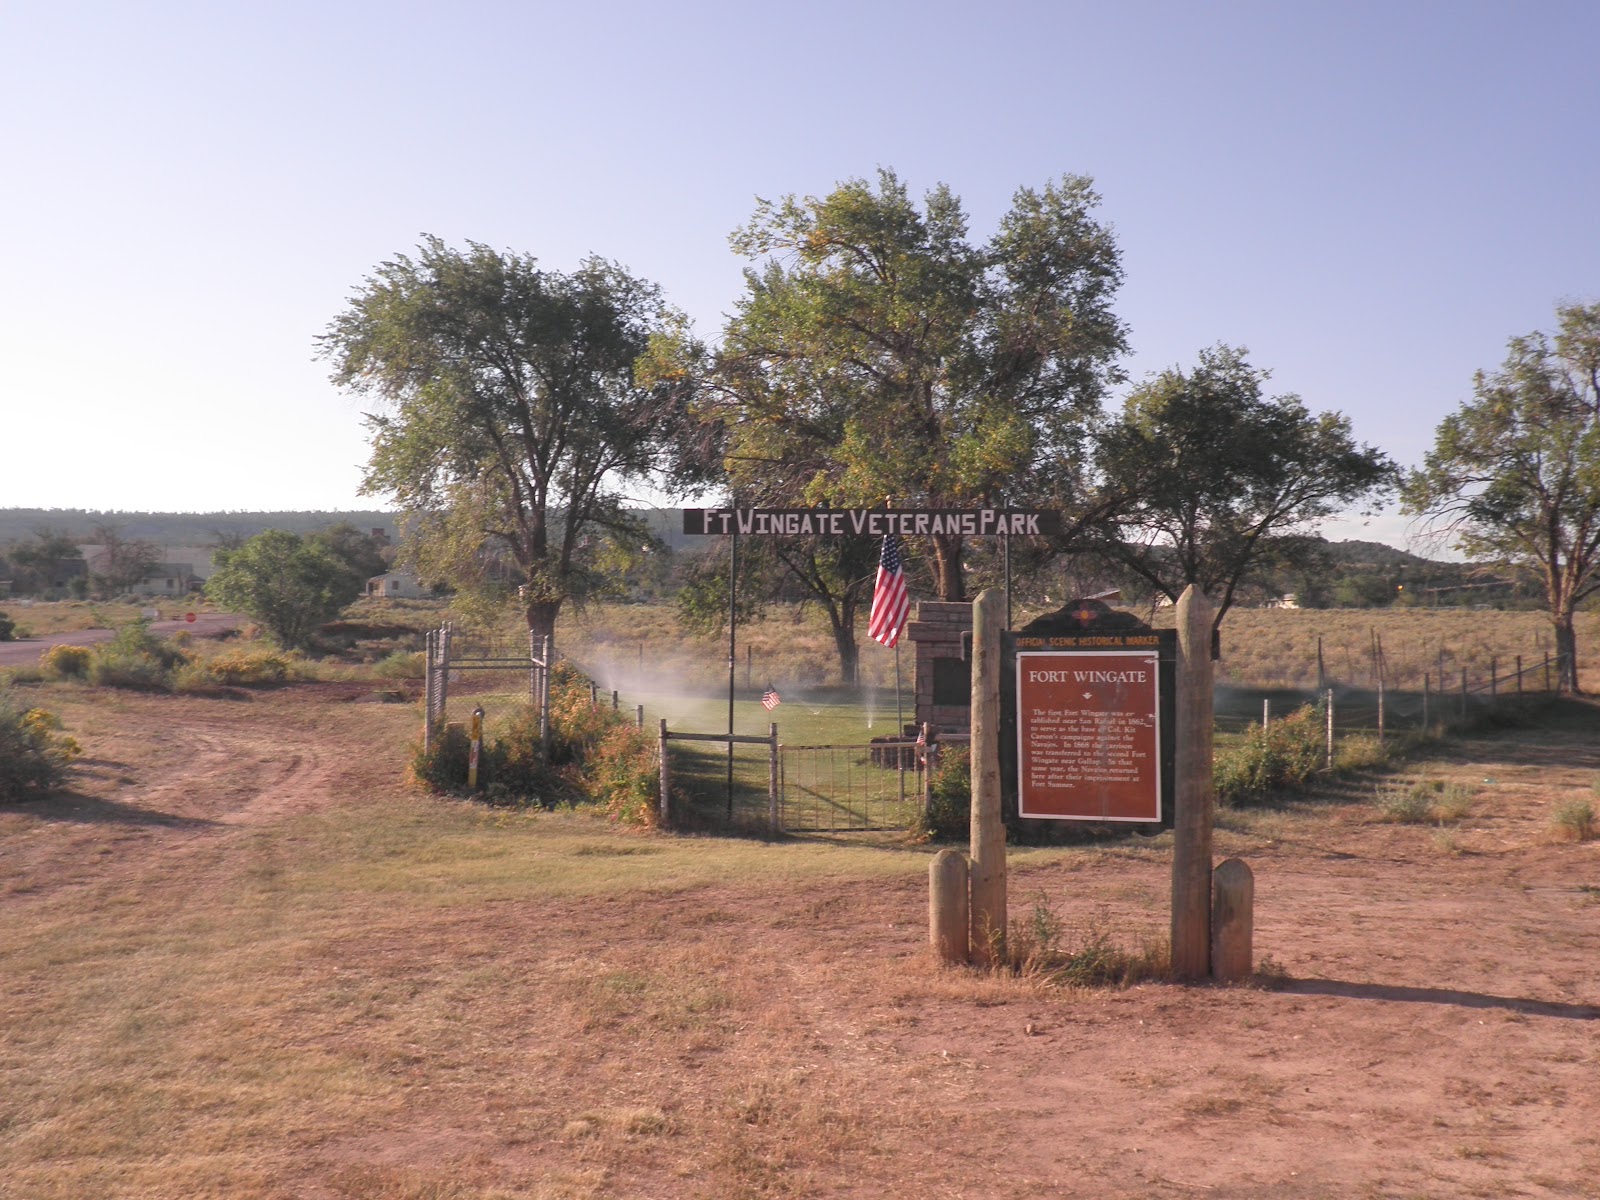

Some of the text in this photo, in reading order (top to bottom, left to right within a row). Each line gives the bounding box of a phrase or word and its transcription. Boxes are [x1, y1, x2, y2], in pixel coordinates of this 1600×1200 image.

[703, 510, 731, 534] FT
[1049, 637, 1076, 646] SCENIC
[1079, 636, 1123, 646] HISTORICAL
[1126, 636, 1159, 645] MARKER
[1029, 671, 1147, 683] FORT WINGATE
